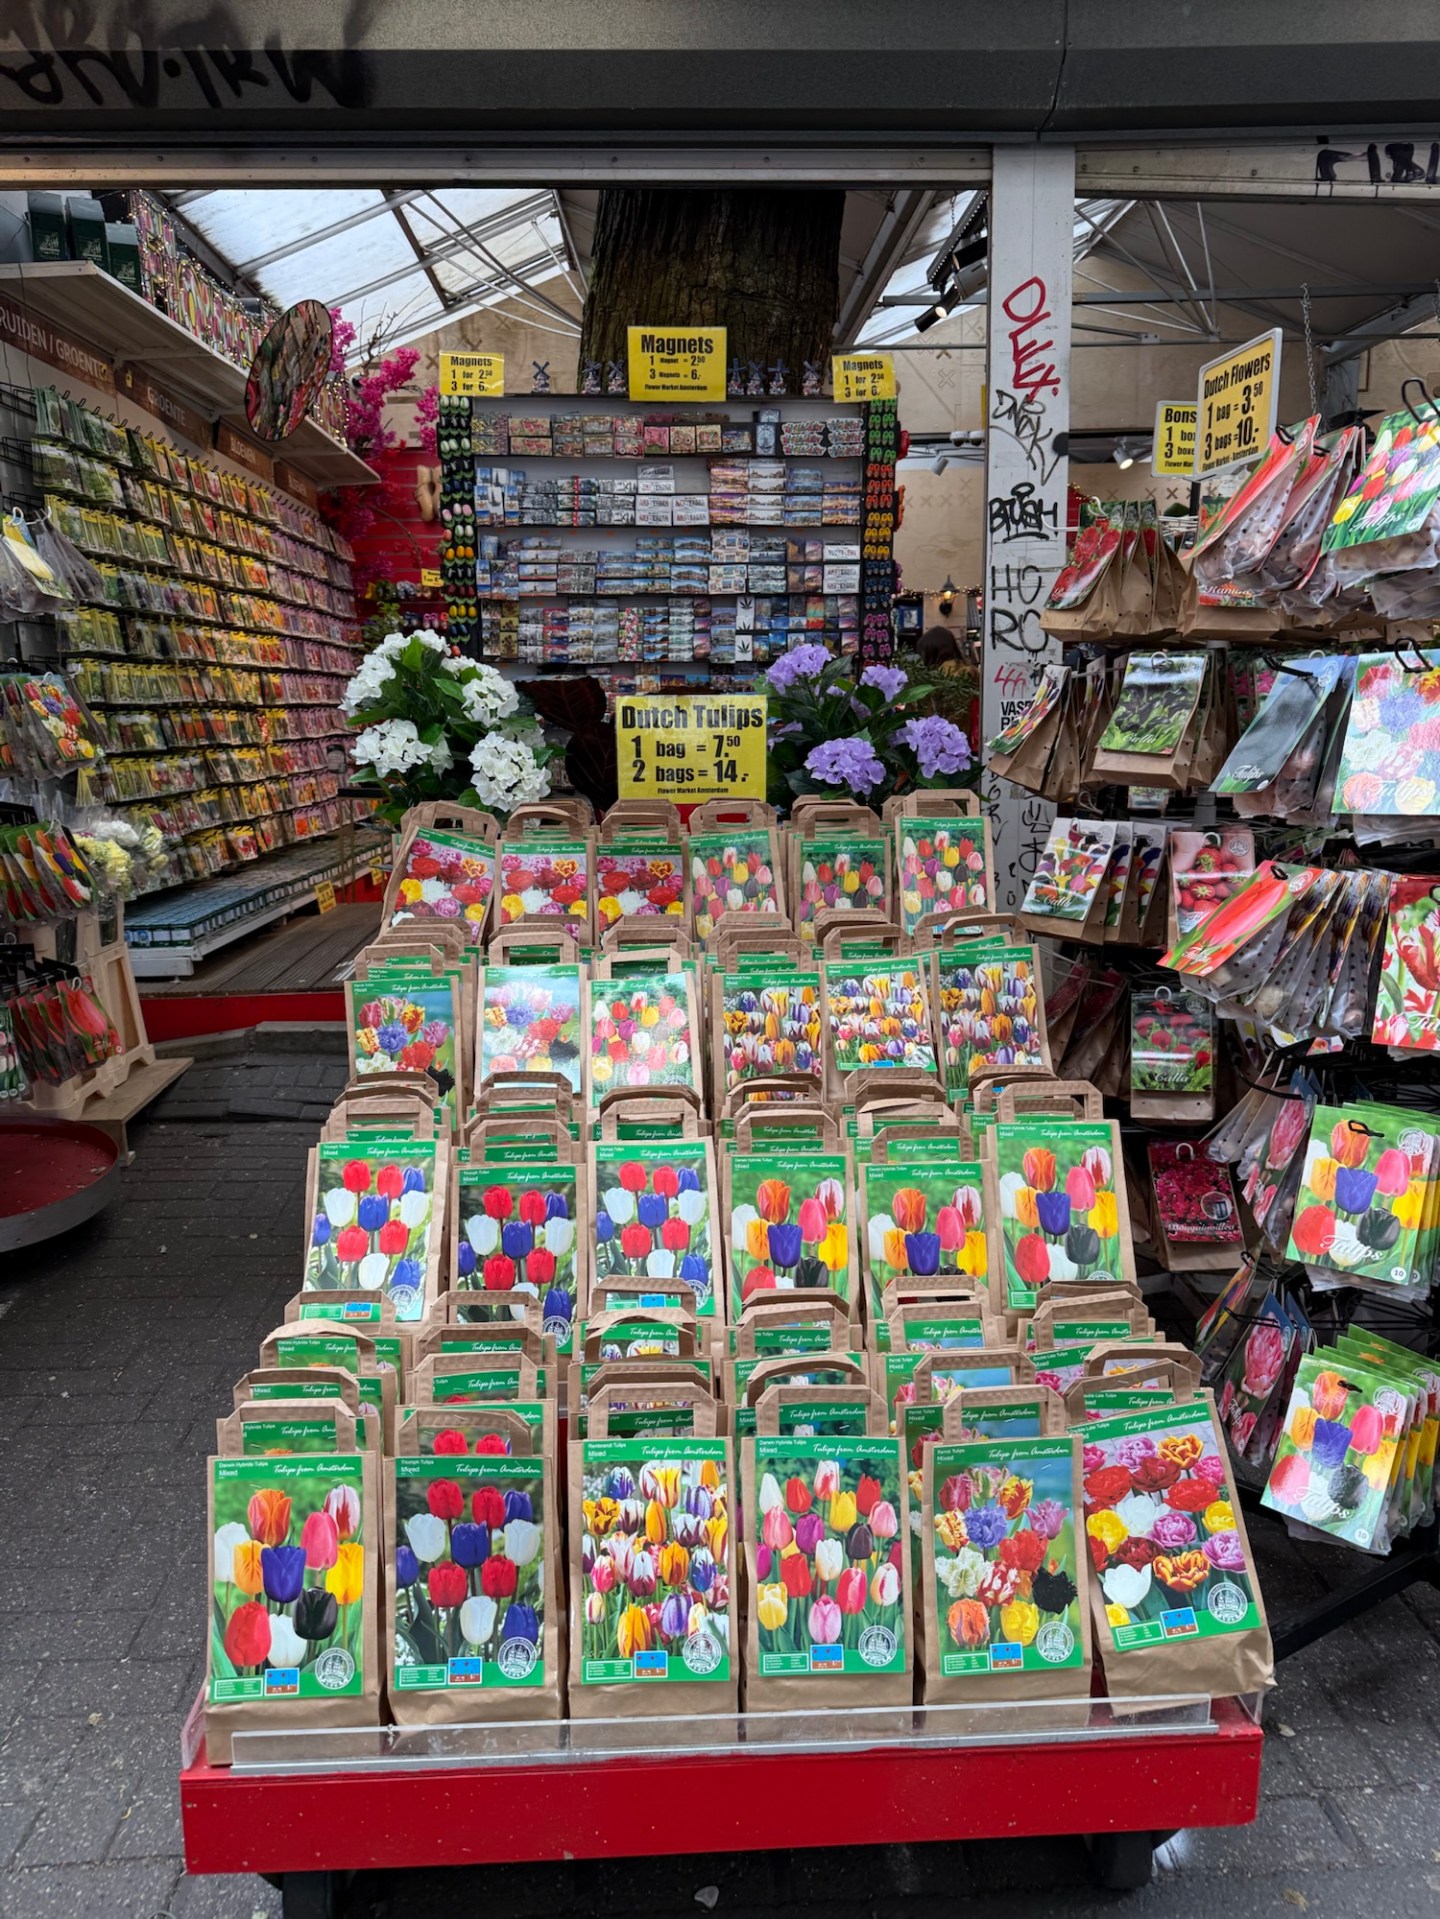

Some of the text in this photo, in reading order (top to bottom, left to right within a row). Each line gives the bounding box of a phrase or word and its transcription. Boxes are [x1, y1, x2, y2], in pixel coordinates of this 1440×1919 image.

[641, 334, 714, 355] Magnets
[450, 355, 493, 367] Magnets
[649, 355, 654, 366] 1
[843, 360, 883, 372] Magnets
[451, 369, 456, 379] 1
[649, 368, 656, 380] 3
[844, 375, 849, 385] 1
[855, 376, 866, 384] for
[1204, 352, 1271, 400] Dutch Flowers
[451, 381, 457, 391] 3
[844, 387, 851, 398] 3
[1207, 381, 1263, 429] 1 bag 3.50
[1166, 426, 1173, 442] 1
[1164, 442, 1173, 459] 3
[1204, 432, 1213, 461] 3
[1215, 432, 1232, 451] bags
[1216, 455, 1230, 468] Market
[1232, 446, 1259, 461] Amsterdam
[1348, 511, 1405, 532] Tulips
[621, 704, 764, 730] Dutch Tulips
[631, 735, 642, 759] 1
[655, 740, 686, 759] bag
[712, 735, 741, 758] 7.50
[632, 759, 646, 782] 2
[655, 765, 694, 784] bags
[1232, 764, 1263, 782] Tulips
[1154, 1072, 1190, 1083] Calla
[1320, 1234, 1383, 1262] Tulips
[1393, 1270, 1405, 1278] 10
[324, 1343, 344, 1353] Tulips
[789, 1409, 810, 1419] Tulips
[1123, 1410, 1208, 1432] Tulips from Amsterdam
[641, 1445, 724, 1458] Tulips from Amsterdam
[813, 1443, 897, 1456] Tulips from Amsterdam
[988, 1445, 1070, 1461] Tulips from Amsterdam
[219, 1469, 238, 1477] Mixed
[273, 1463, 356, 1477] Tulips from Amsterdam
[456, 1463, 541, 1477] Tulips from Amsterdam
[1293, 1485, 1350, 1519] Tulips
